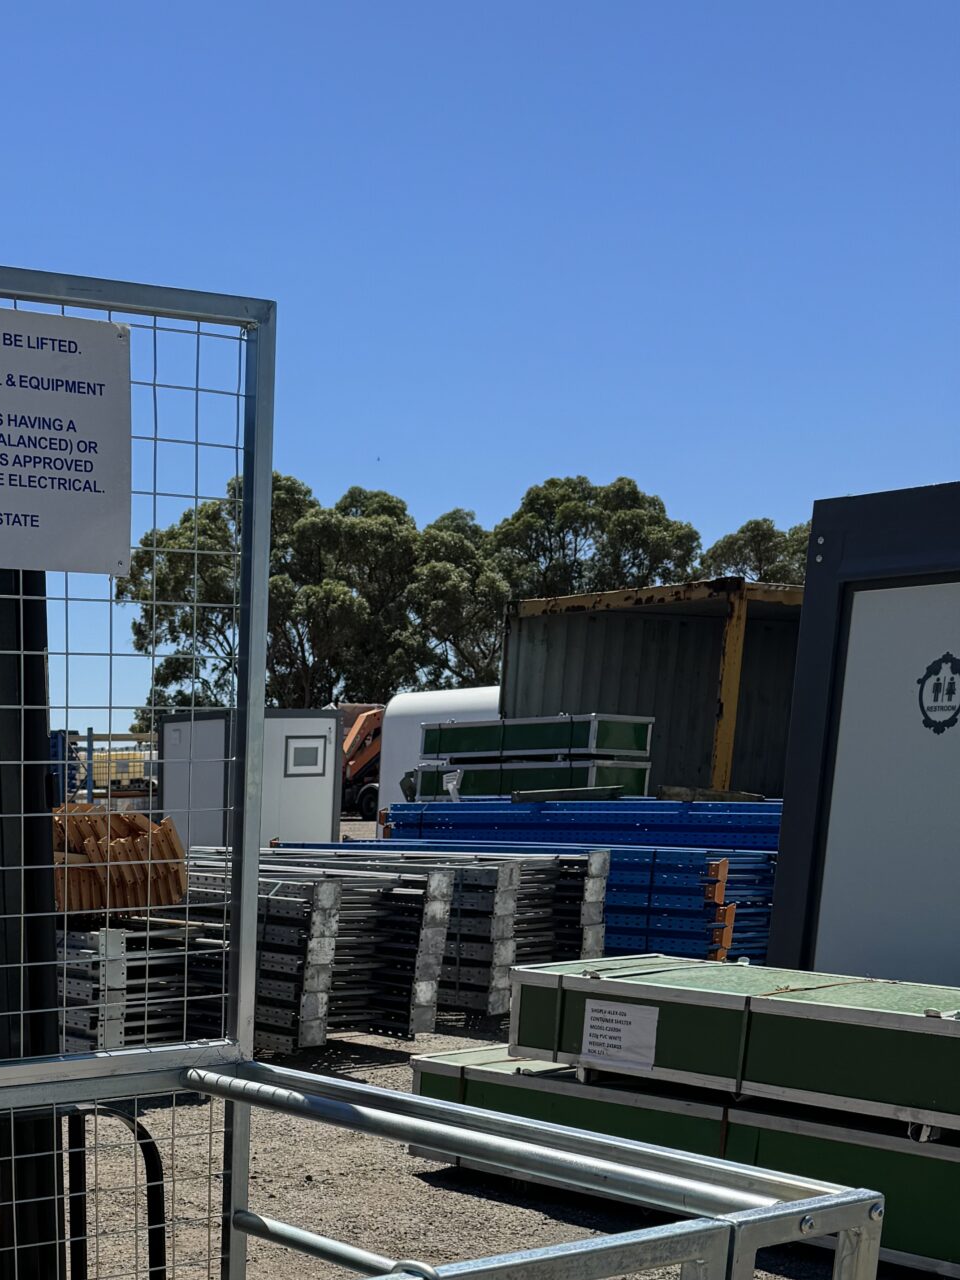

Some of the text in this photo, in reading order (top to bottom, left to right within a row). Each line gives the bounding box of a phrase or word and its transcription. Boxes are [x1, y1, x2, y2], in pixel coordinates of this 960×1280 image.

[3, 333, 23, 347] BE
[28, 336, 81, 354] LIFTED.
[6, 374, 16, 387] &
[19, 375, 105, 396] EQUIPMENT
[8, 414, 63, 431] HAVING
[66, 420, 76, 432] A
[77, 440, 98, 454] OR
[12, 454, 93, 472] APPROVED
[8, 474, 104, 493] ELECTRICAL.
